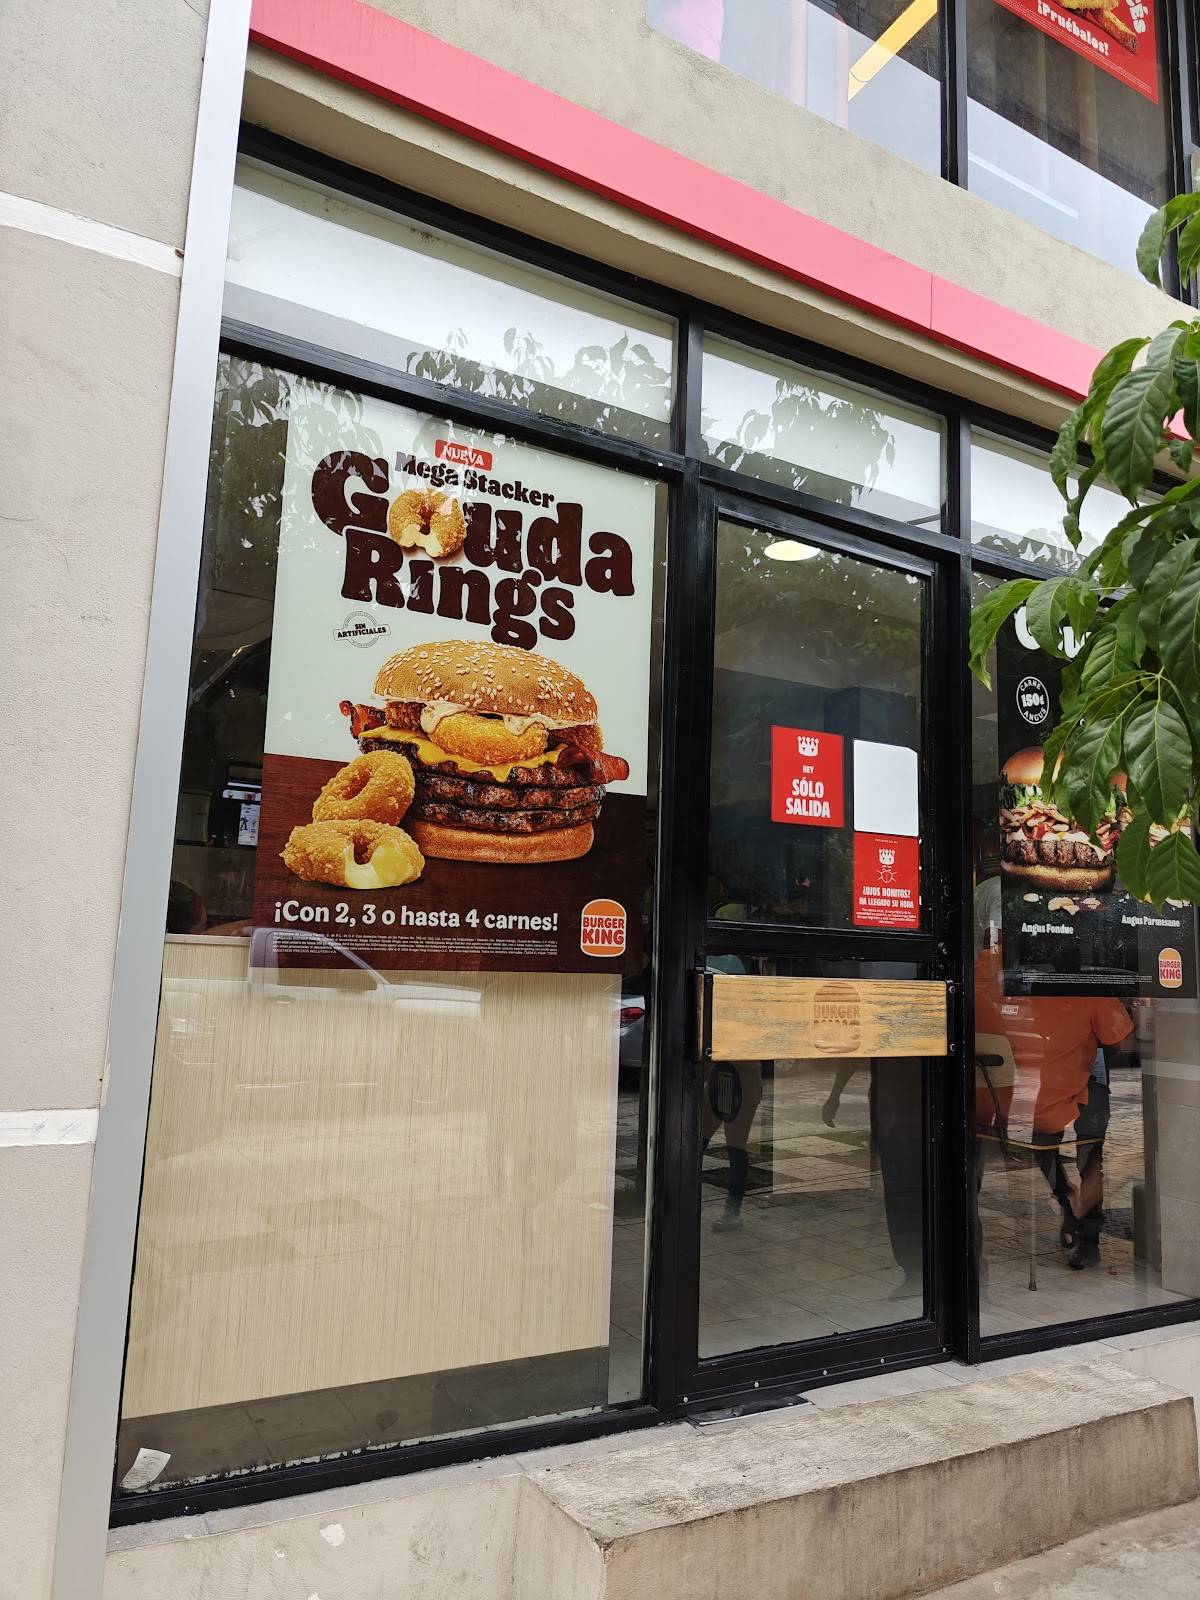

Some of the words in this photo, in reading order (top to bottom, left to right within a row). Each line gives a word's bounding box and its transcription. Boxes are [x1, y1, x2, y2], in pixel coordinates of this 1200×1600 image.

[1037, 1, 1109, 56] ¡Pruébalos!
[441, 445, 485, 466] NUEVA
[394, 451, 459, 489] Mega
[462, 466, 555, 509] Stacker
[341, 528, 576, 650] Rings
[337, 627, 387, 638] ARTIFICIALES
[1020, 680, 1042, 692] CARNE
[1023, 707, 1047, 721] ANGUS
[802, 765, 814, 774] HEY
[792, 777, 824, 797] SÓLO
[785, 798, 830, 818] SALIDA
[274, 900, 330, 923] ¡Con
[334, 904, 357, 929] 2,
[362, 904, 377, 925] 3
[381, 911, 395, 927] o
[400, 906, 460, 928] hasta
[464, 909, 480, 928] 4
[484, 912, 559, 932] carnes!
[582, 916, 625, 929] BURGER
[1121, 915, 1143, 927] Angus
[1143, 916, 1181, 928] Parmesano
[582, 927, 625, 945] KING
[1021, 922, 1046, 936] Angus
[1046, 923, 1074, 935] Fondue
[1159, 960, 1181, 969] BURGER
[1160, 968, 1182, 980] KING
[814, 1003, 861, 1019] BURGER
